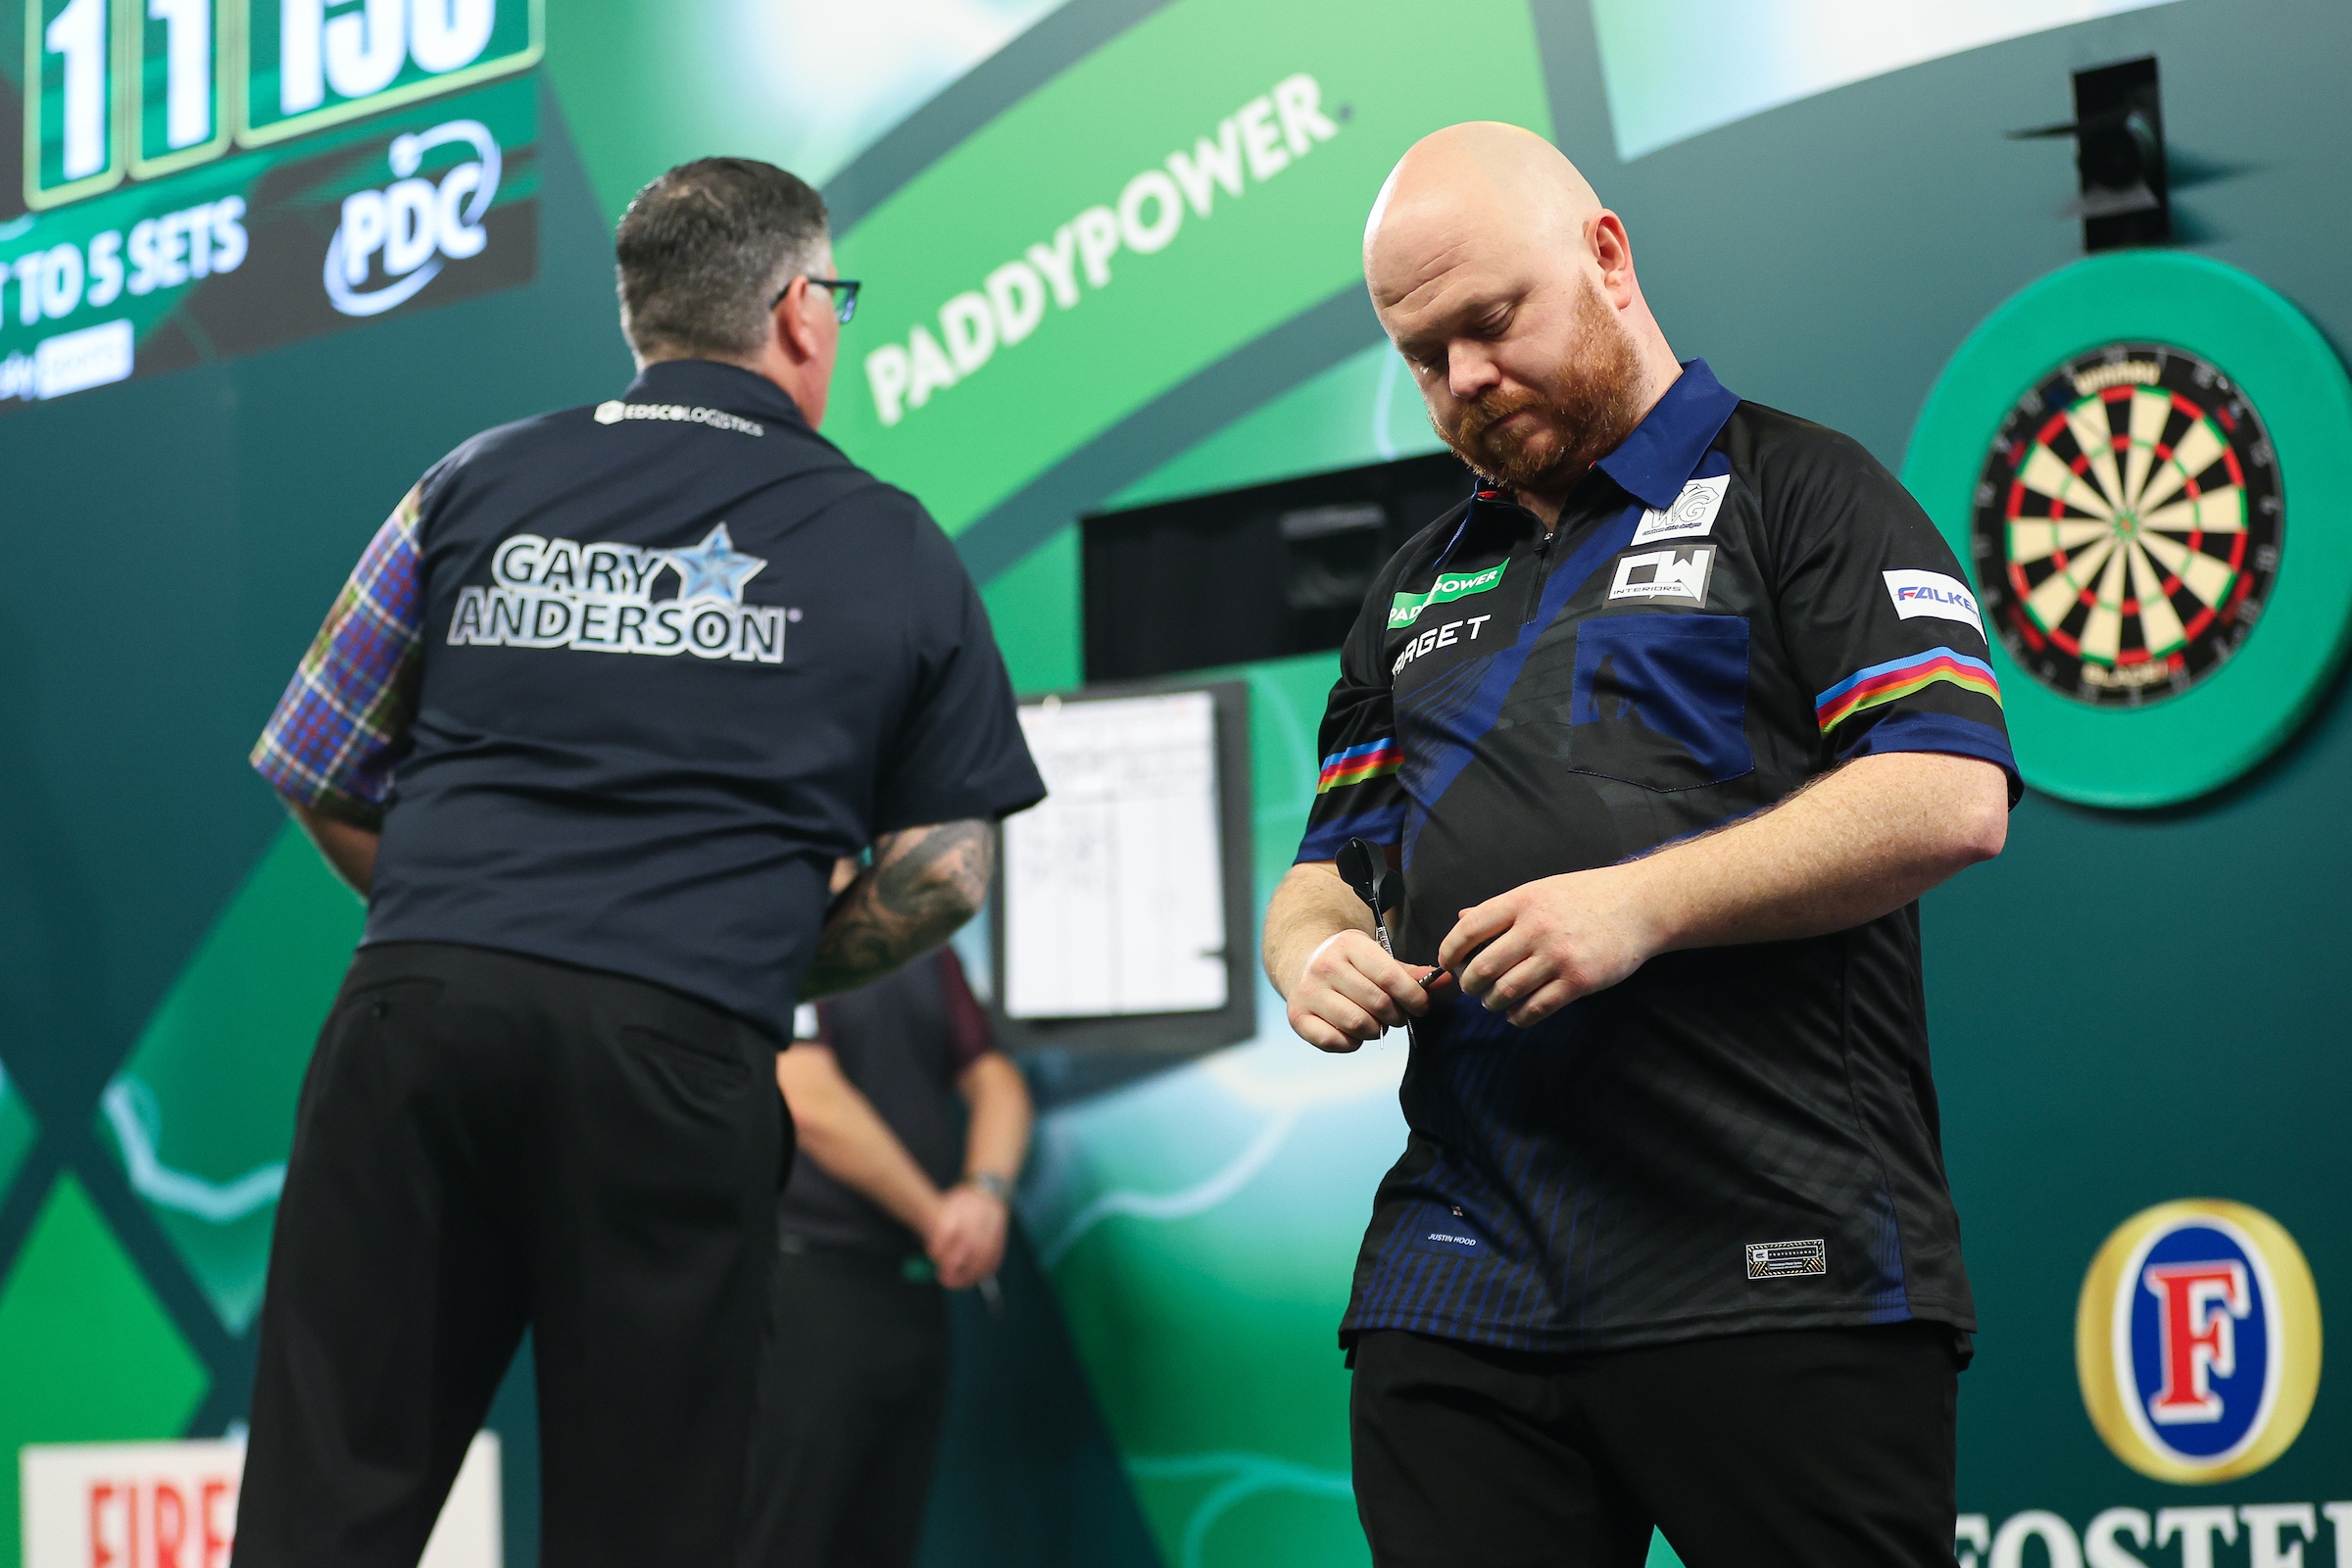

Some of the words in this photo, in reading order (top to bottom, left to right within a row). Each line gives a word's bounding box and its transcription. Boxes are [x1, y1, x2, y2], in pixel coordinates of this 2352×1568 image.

[46, 0, 106, 181] 1
[148, 0, 212, 150] 1
[13, 242, 84, 326] TO
[87, 229, 124, 308] 5
[126, 195, 249, 296] SETS
[341, 161, 488, 287] PDC
[864, 73, 1339, 426] PADDYPOWER
[494, 536, 662, 600] GARY
[1613, 585, 1682, 595] INTERIORS
[447, 587, 785, 663] ANDERSON
[1392, 613, 1492, 676] ARGET
[1428, 1233, 1453, 1244] JUSTIN
[1453, 1236, 1477, 1247] HOOD
[2143, 1258, 2253, 1427] F
[1955, 1500, 2352, 1568] OSTE
